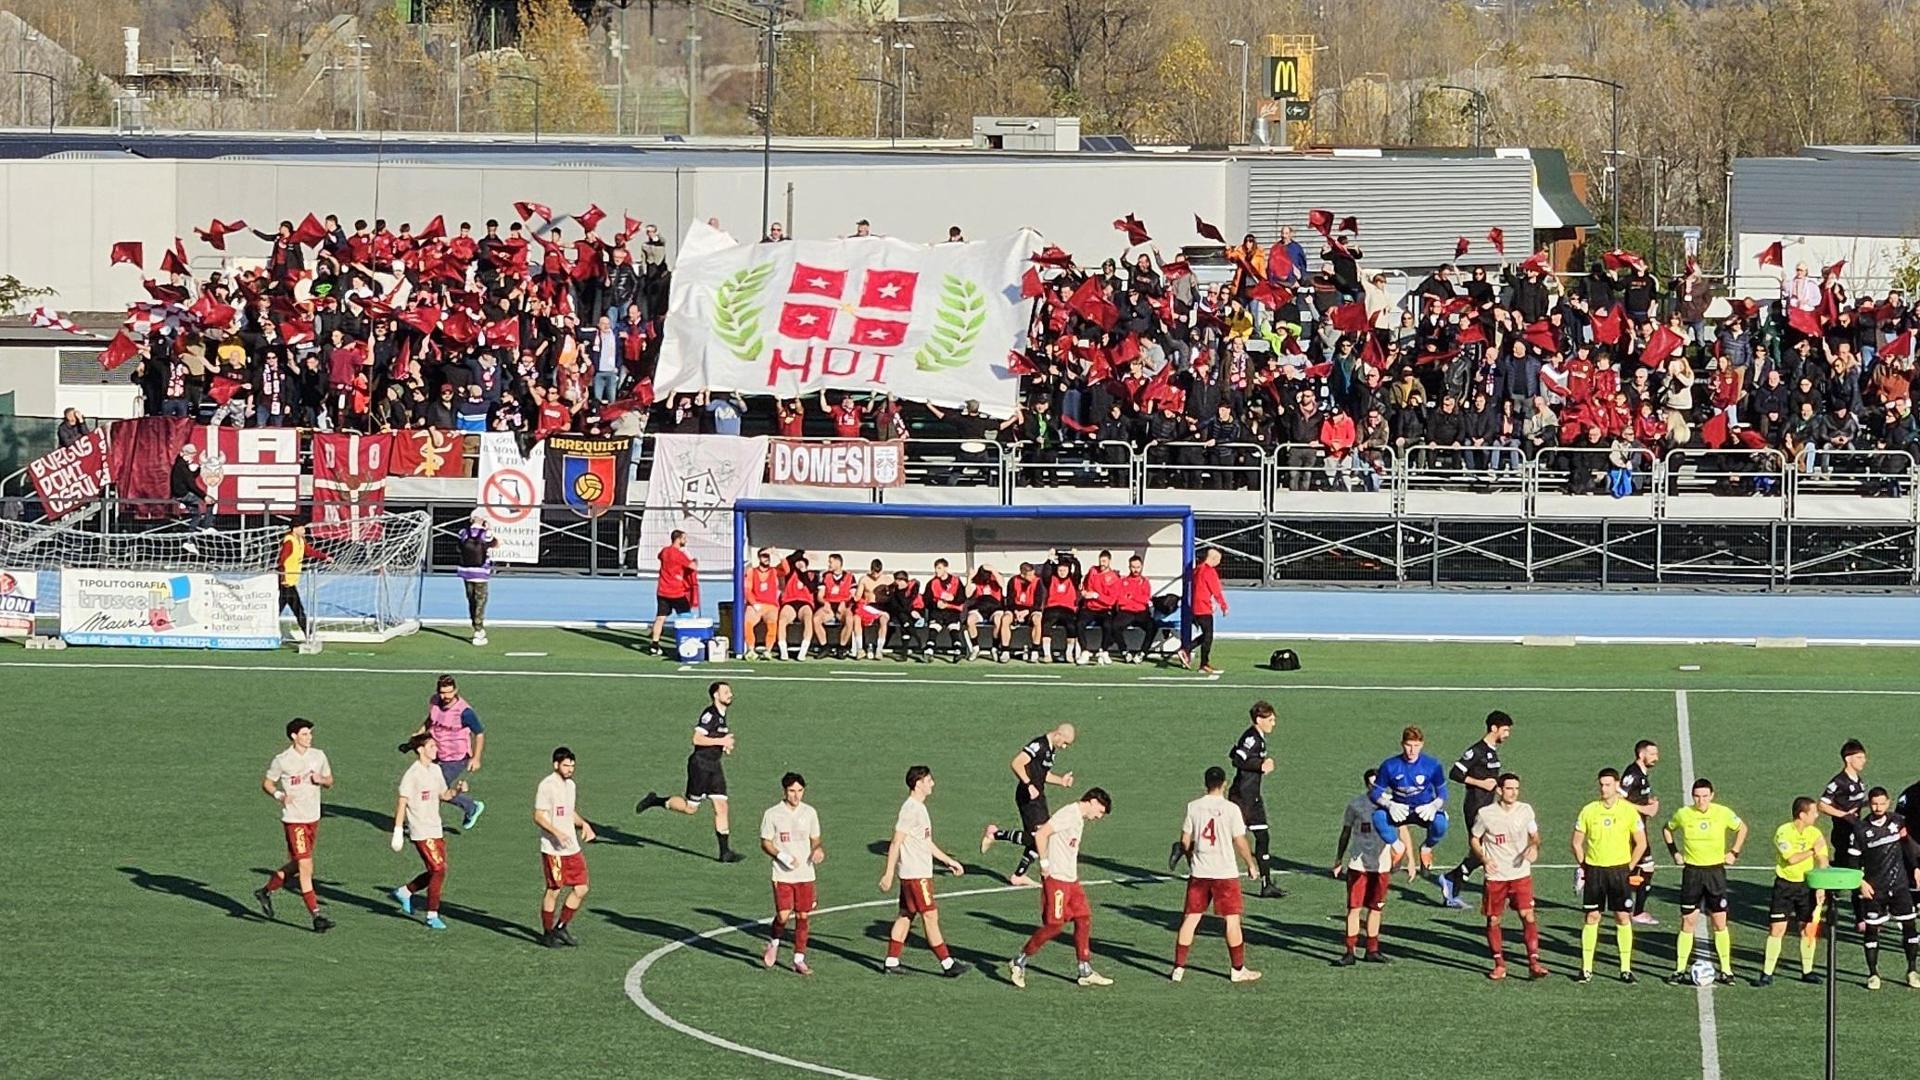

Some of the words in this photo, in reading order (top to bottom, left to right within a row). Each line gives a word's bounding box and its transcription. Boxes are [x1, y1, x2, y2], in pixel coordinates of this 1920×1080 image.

[549, 437, 630, 452] IRREQUIETI
[774, 444, 872, 484] DOMESI
[79, 579, 167, 589] TIPOLITOGRAFIA
[1202, 818, 1216, 846] 4
